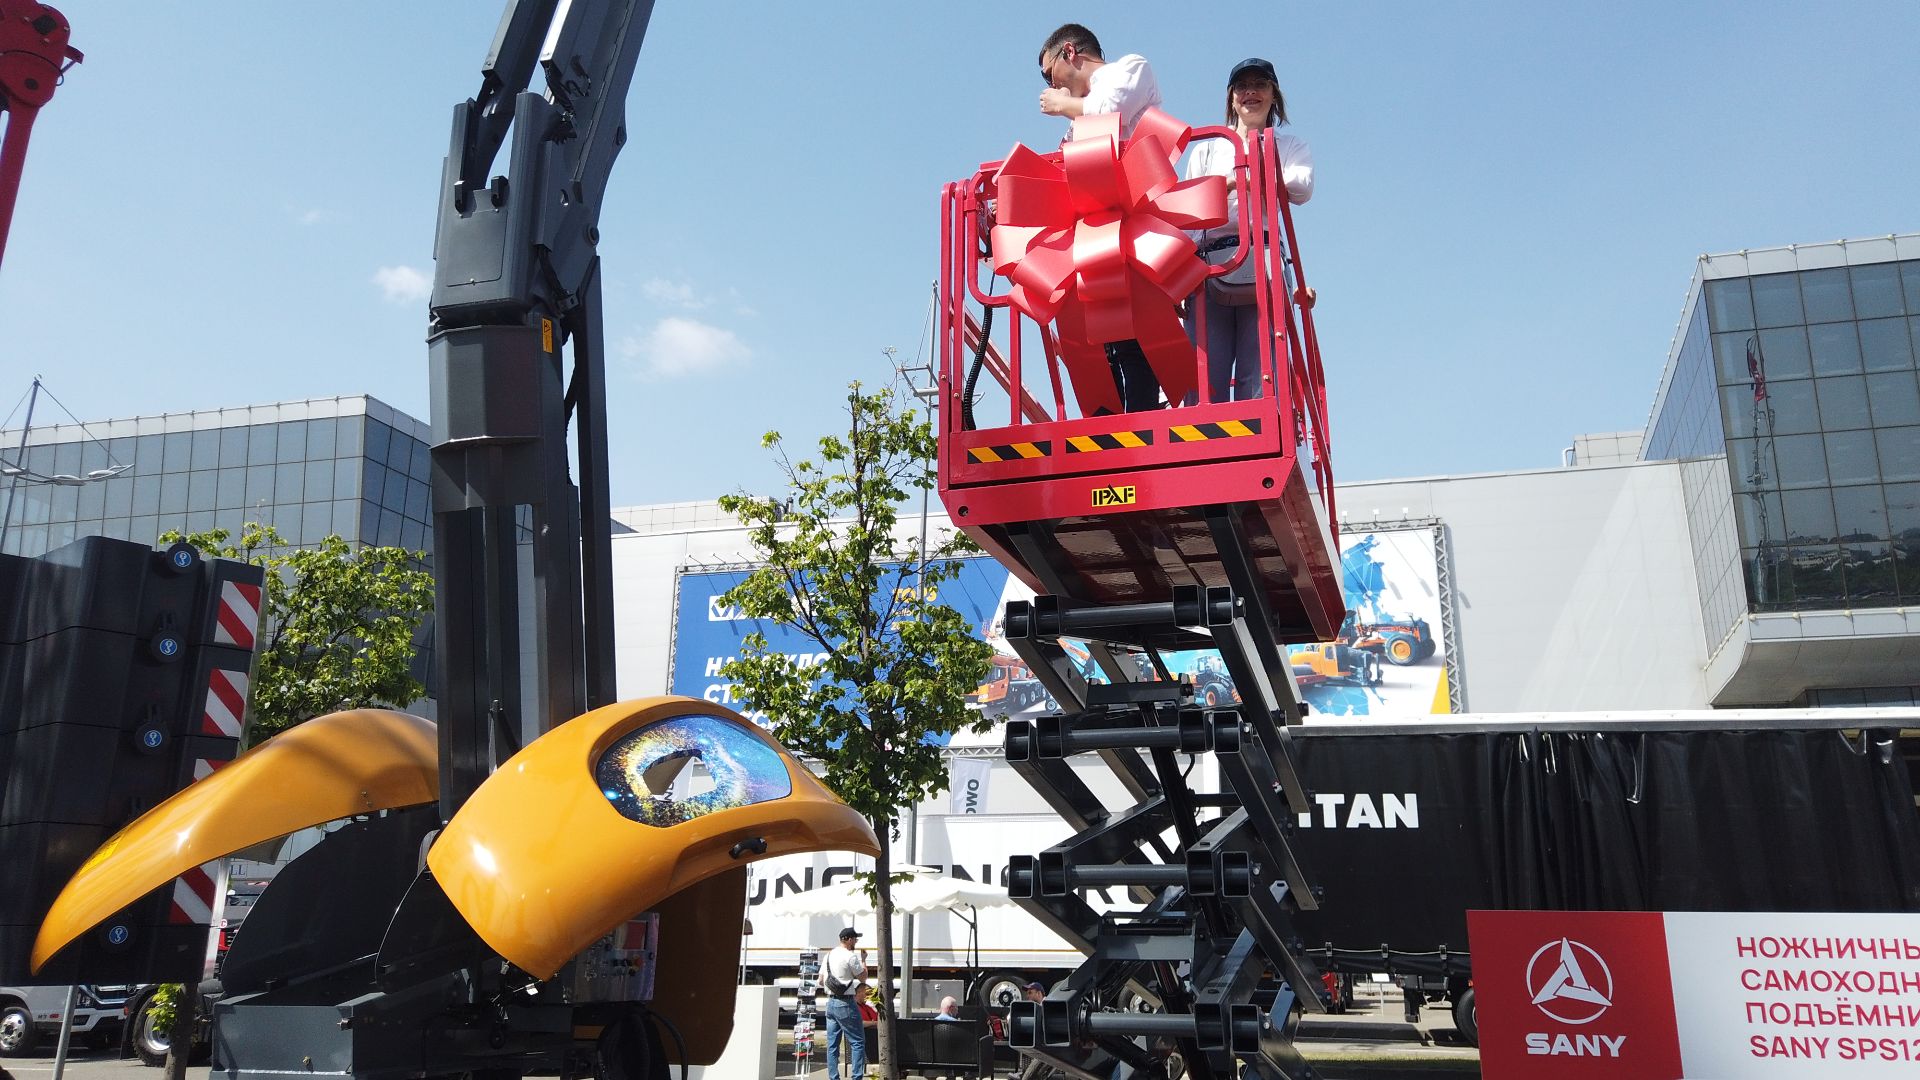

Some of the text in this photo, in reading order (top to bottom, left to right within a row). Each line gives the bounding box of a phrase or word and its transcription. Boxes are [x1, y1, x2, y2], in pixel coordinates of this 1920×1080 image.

[1093, 484, 1134, 505] IPAF
[1741, 968, 1920, 996] САМОХОДН
[1525, 1033, 1627, 1057] SANY
[1750, 1035, 1830, 1060] SANY
